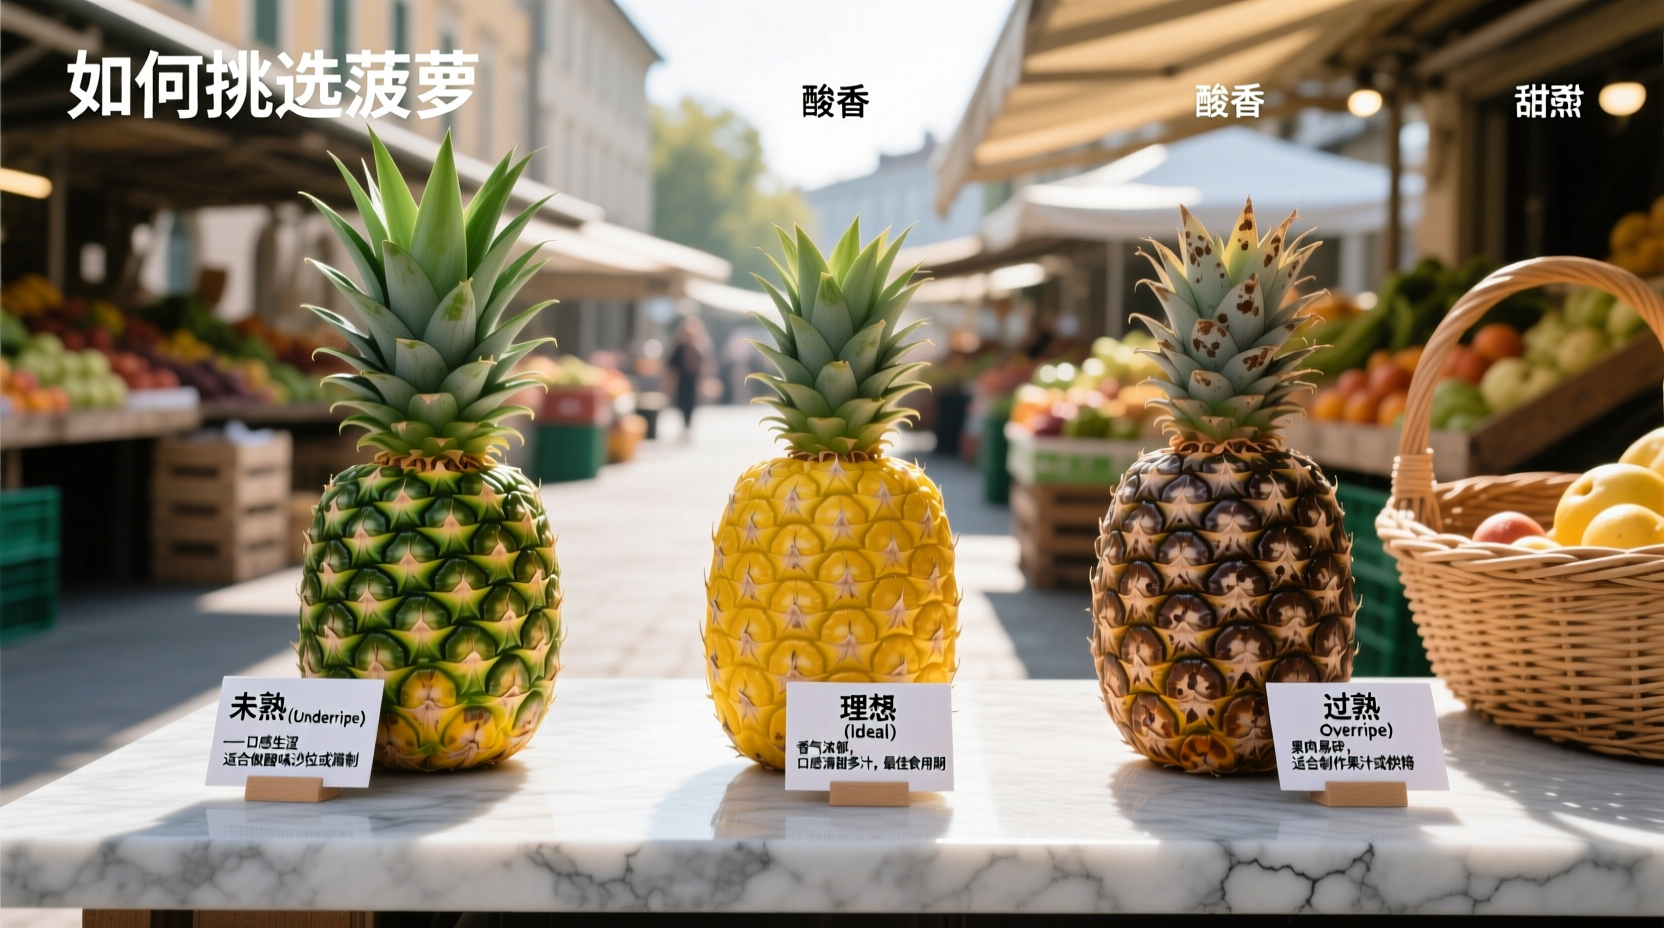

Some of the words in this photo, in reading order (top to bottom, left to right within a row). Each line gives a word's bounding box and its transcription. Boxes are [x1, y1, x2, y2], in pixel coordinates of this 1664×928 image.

[229, 692, 287, 722] 未熟
[287, 707, 366, 728] (Underripe)
[839, 693, 897, 722] 理想
[1323, 691, 1381, 721] 过熟
[844, 723, 897, 742] (Ideal)
[1319, 722, 1394, 741] Overripe)
